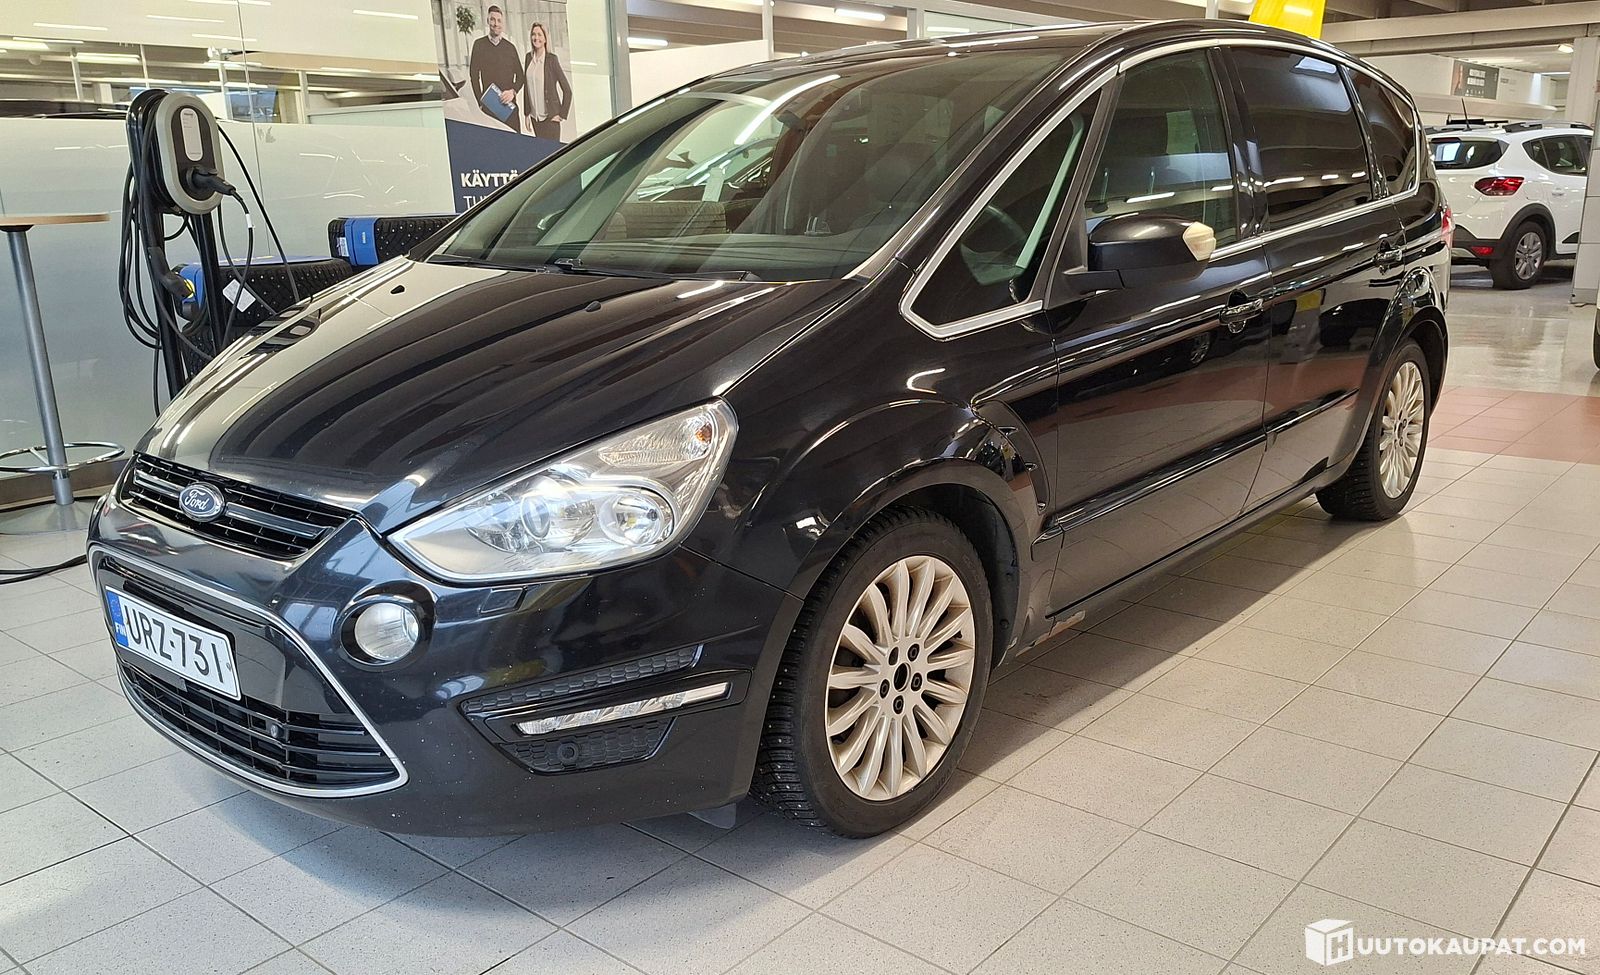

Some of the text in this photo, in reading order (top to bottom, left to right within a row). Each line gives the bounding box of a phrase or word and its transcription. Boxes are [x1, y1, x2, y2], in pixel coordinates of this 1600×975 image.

[184, 489, 210, 510] Ford
[114, 622, 127, 637] FIN
[124, 605, 223, 683] URZ-731
